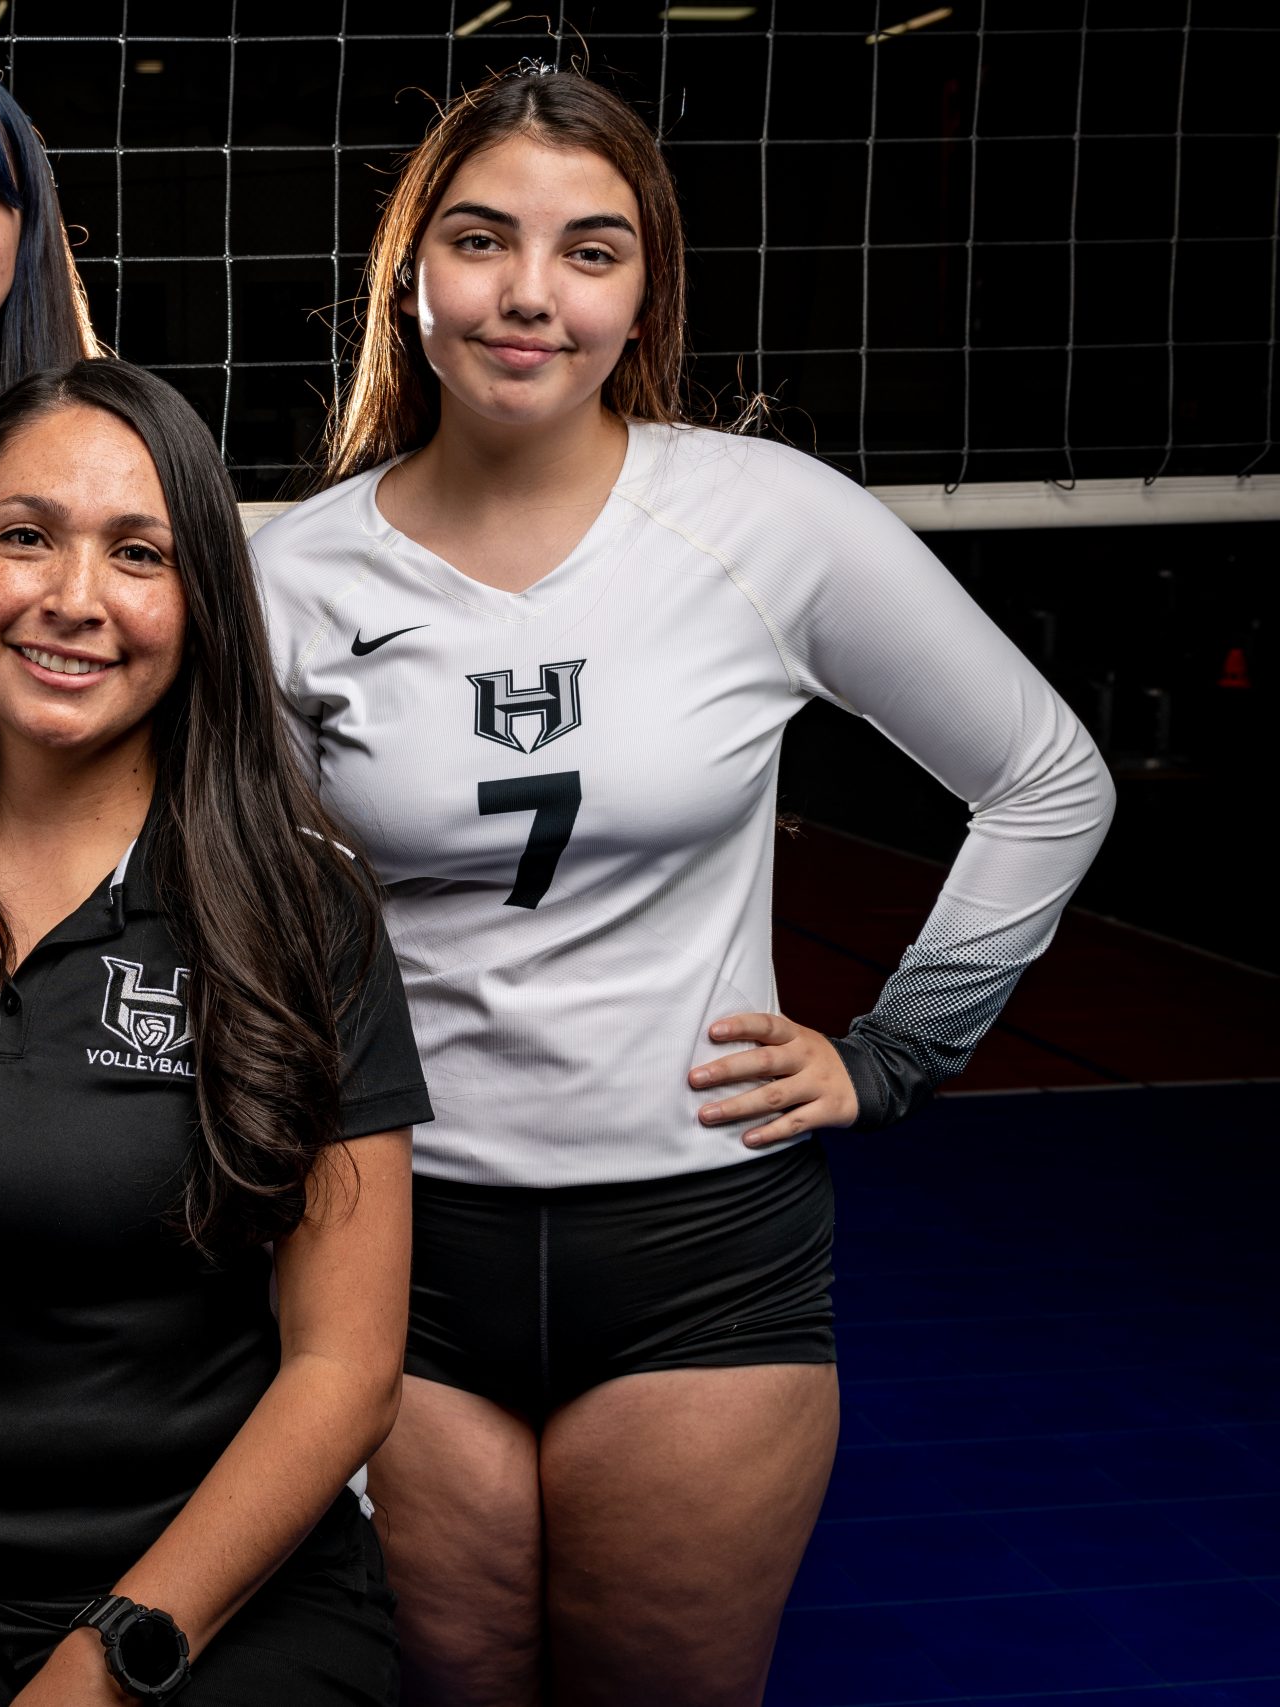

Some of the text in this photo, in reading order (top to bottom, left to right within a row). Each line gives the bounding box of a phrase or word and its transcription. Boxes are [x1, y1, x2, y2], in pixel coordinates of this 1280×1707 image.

[465, 659, 587, 754] H
[477, 770, 582, 910] 7
[86, 1048, 196, 1077] VOLLEYBAL
